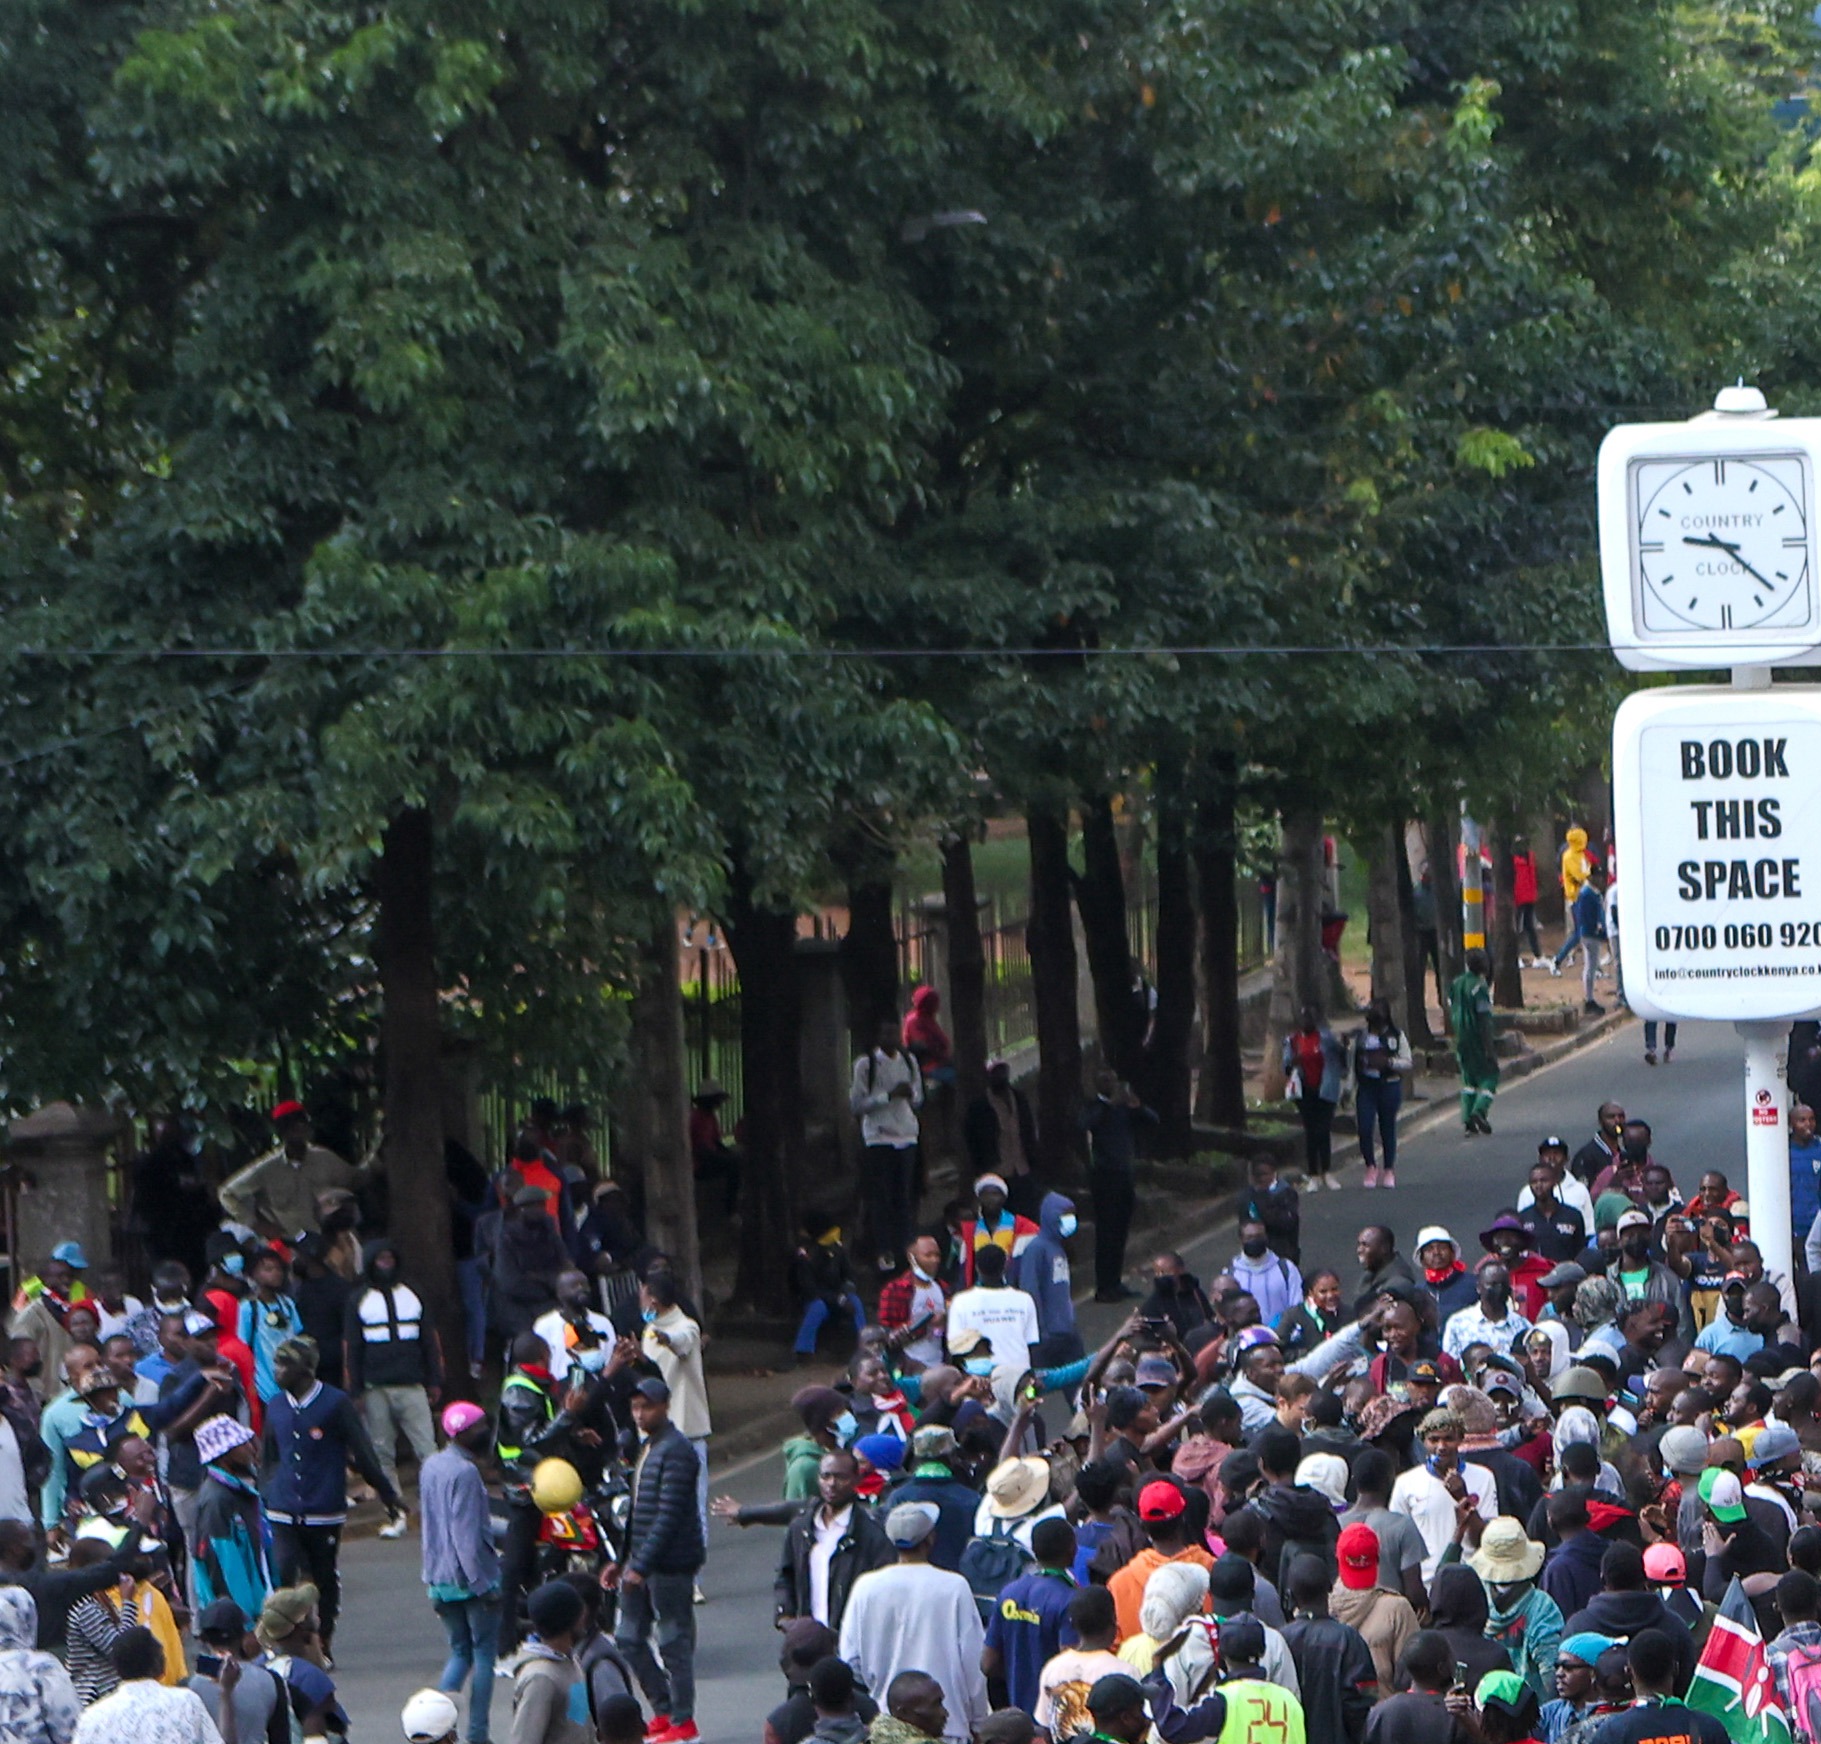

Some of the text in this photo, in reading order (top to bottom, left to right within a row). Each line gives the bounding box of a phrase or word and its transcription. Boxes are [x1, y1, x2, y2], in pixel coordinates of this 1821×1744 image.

[1680, 512, 1764, 530] COUNTRY
[1696, 561, 1753, 576] CLOCK
[1681, 738, 1789, 780] BOOK
[1690, 798, 1782, 840] THIS
[1677, 858, 1802, 902] SPACE
[1654, 924, 1718, 951] 0700
[1723, 923, 1774, 949] 060
